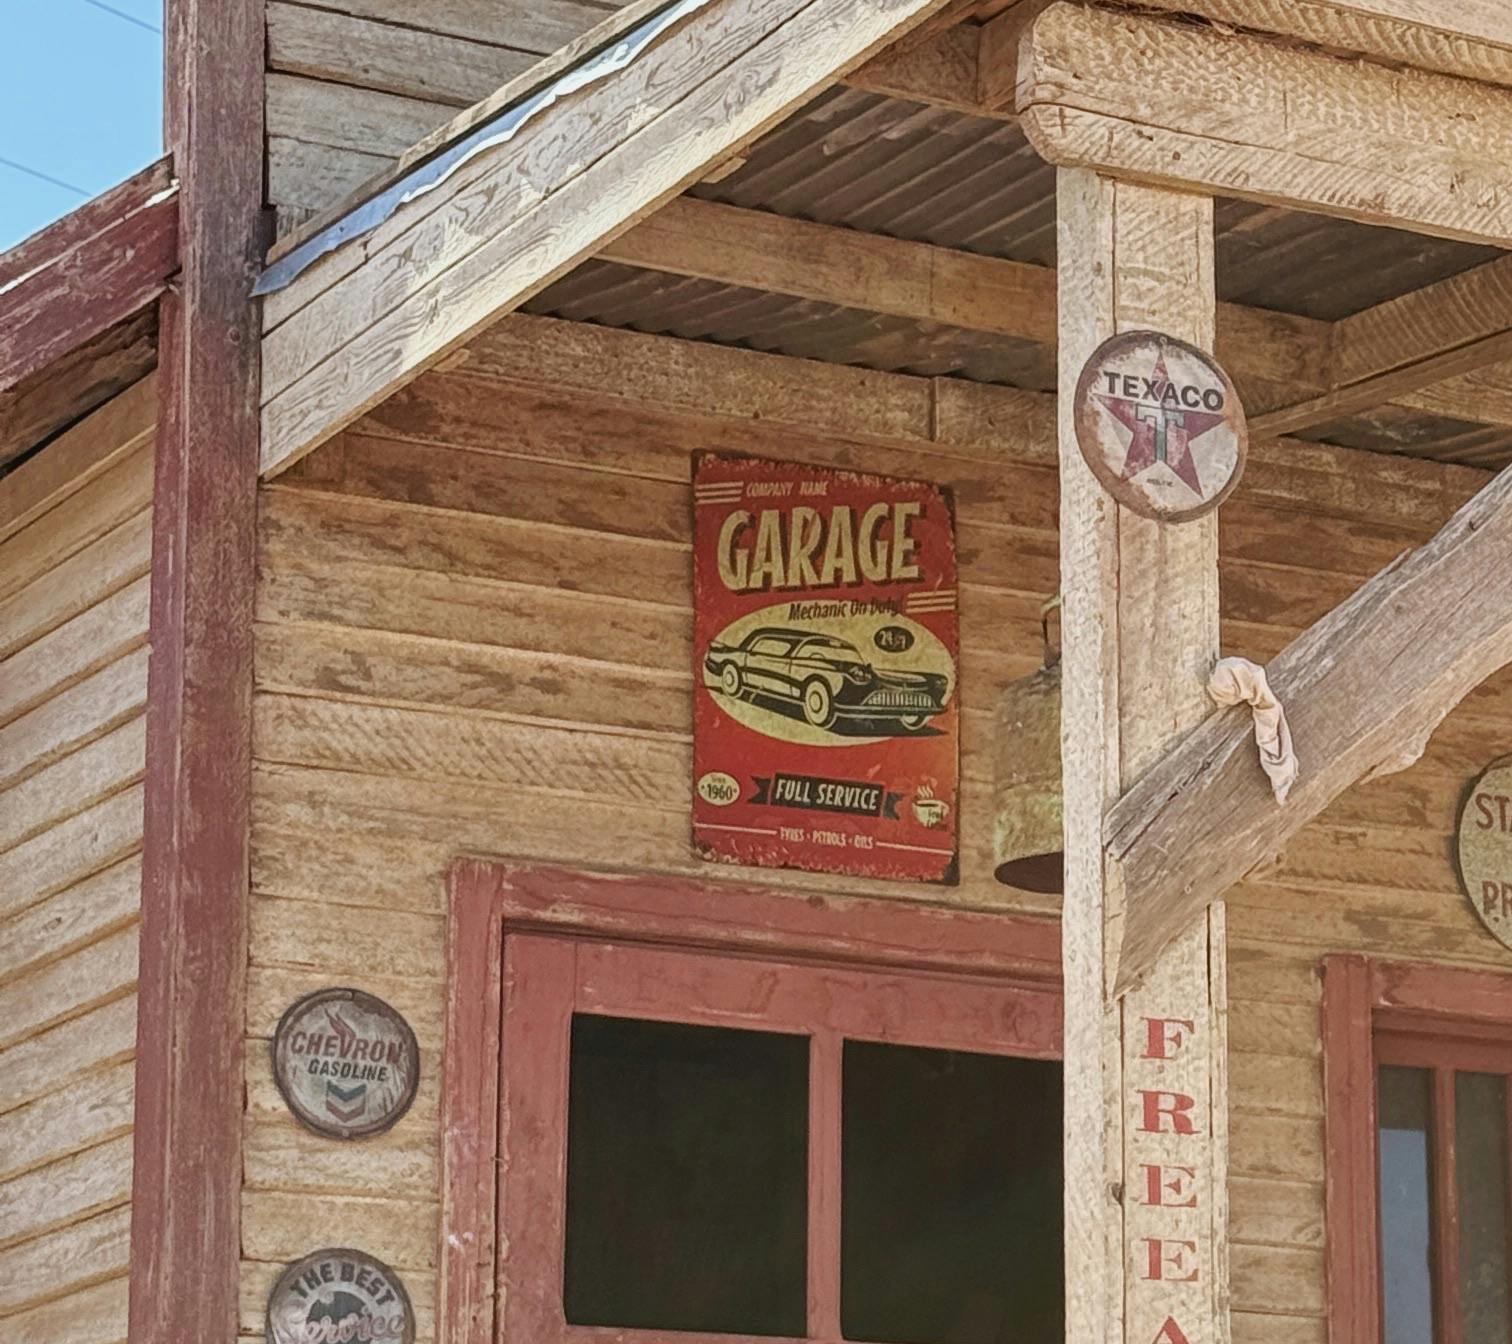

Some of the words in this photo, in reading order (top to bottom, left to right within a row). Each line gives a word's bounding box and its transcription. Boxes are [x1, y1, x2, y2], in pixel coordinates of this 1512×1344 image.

[1103, 370, 1224, 412] TEXACO
[746, 481, 794, 497] COMPANY
[717, 502, 924, 592] GARAGE
[788, 600, 847, 621] Mechanic
[850, 600, 867, 616] On
[707, 783, 733, 801] 1960
[775, 779, 811, 803] FULL
[816, 782, 880, 811] SERVICE
[290, 1027, 404, 1065] CHEVRON
[307, 1057, 388, 1082] GASOLINE
[1136, 1016, 1202, 1282] FREE
[289, 1262, 335, 1299] THE
[340, 1261, 396, 1306] BEST
